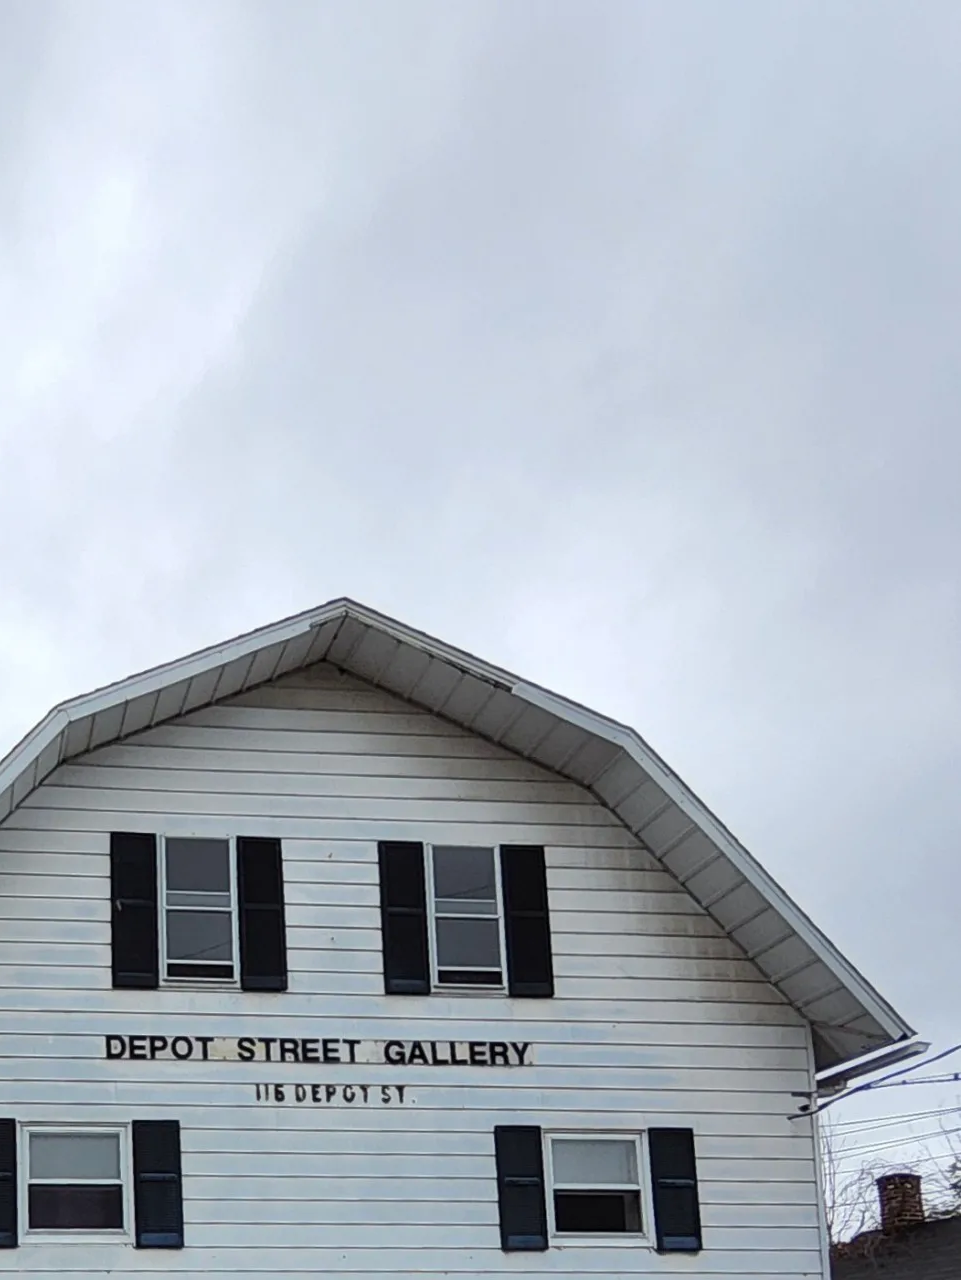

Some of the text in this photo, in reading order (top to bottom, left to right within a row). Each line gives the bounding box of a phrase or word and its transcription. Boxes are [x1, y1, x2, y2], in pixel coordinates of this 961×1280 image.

[105, 1035, 532, 1066] DEPOT STREET GALLERY
[294, 1084, 368, 1103] DEPOT
[381, 1085, 417, 1104] ST.
